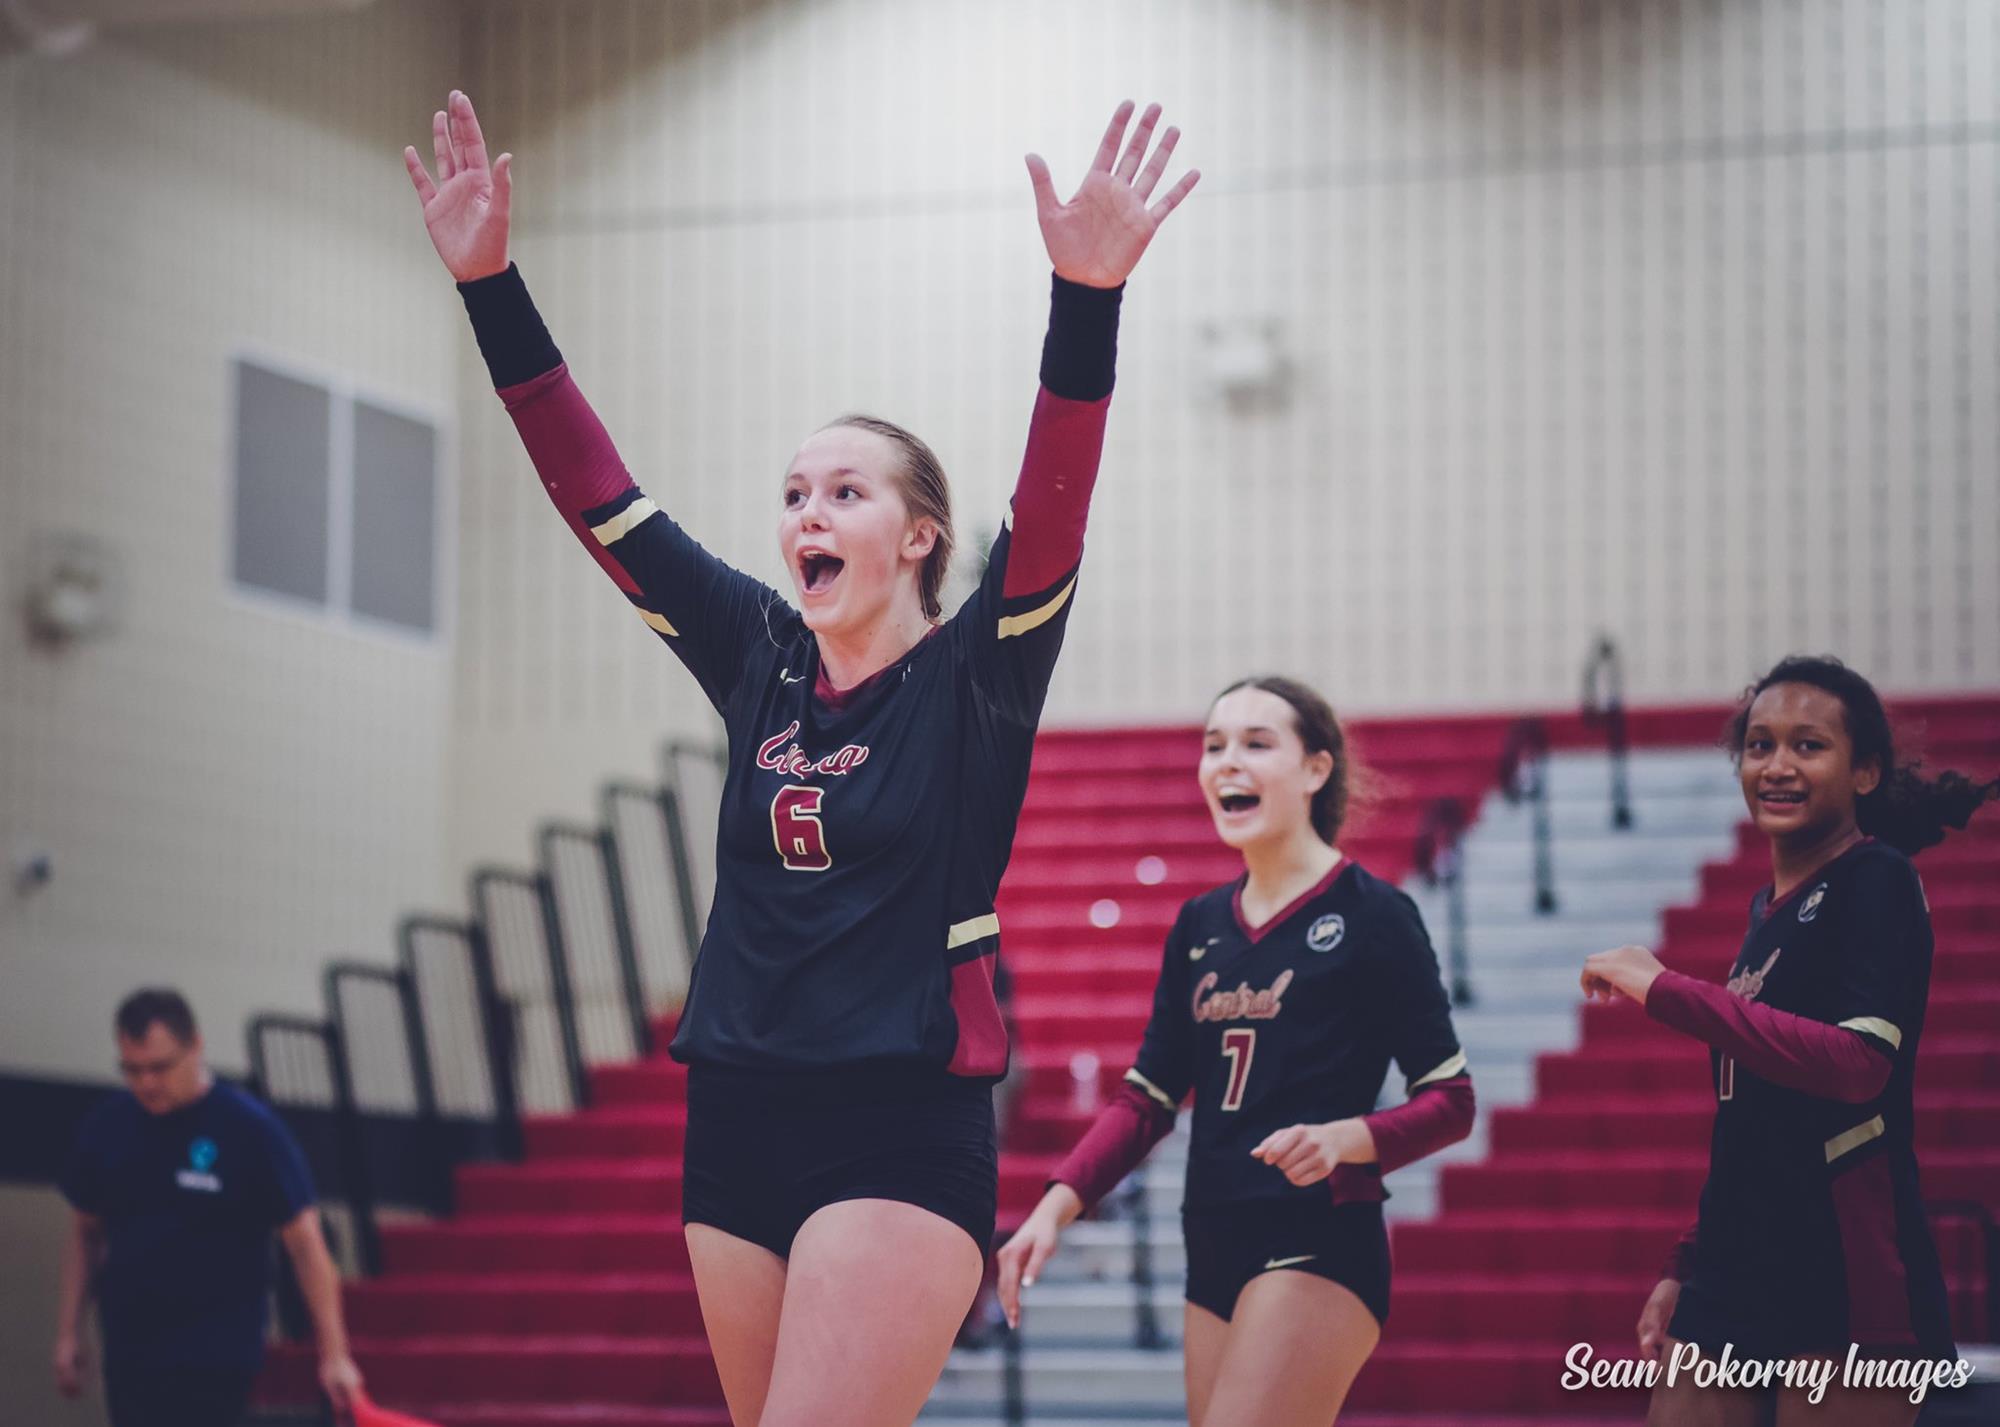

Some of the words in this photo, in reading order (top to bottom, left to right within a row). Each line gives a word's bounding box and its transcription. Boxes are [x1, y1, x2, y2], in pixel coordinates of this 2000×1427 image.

[770, 784, 832, 871] 6
[1192, 968, 1295, 1023] Central
[1221, 1028, 1256, 1111] 7
